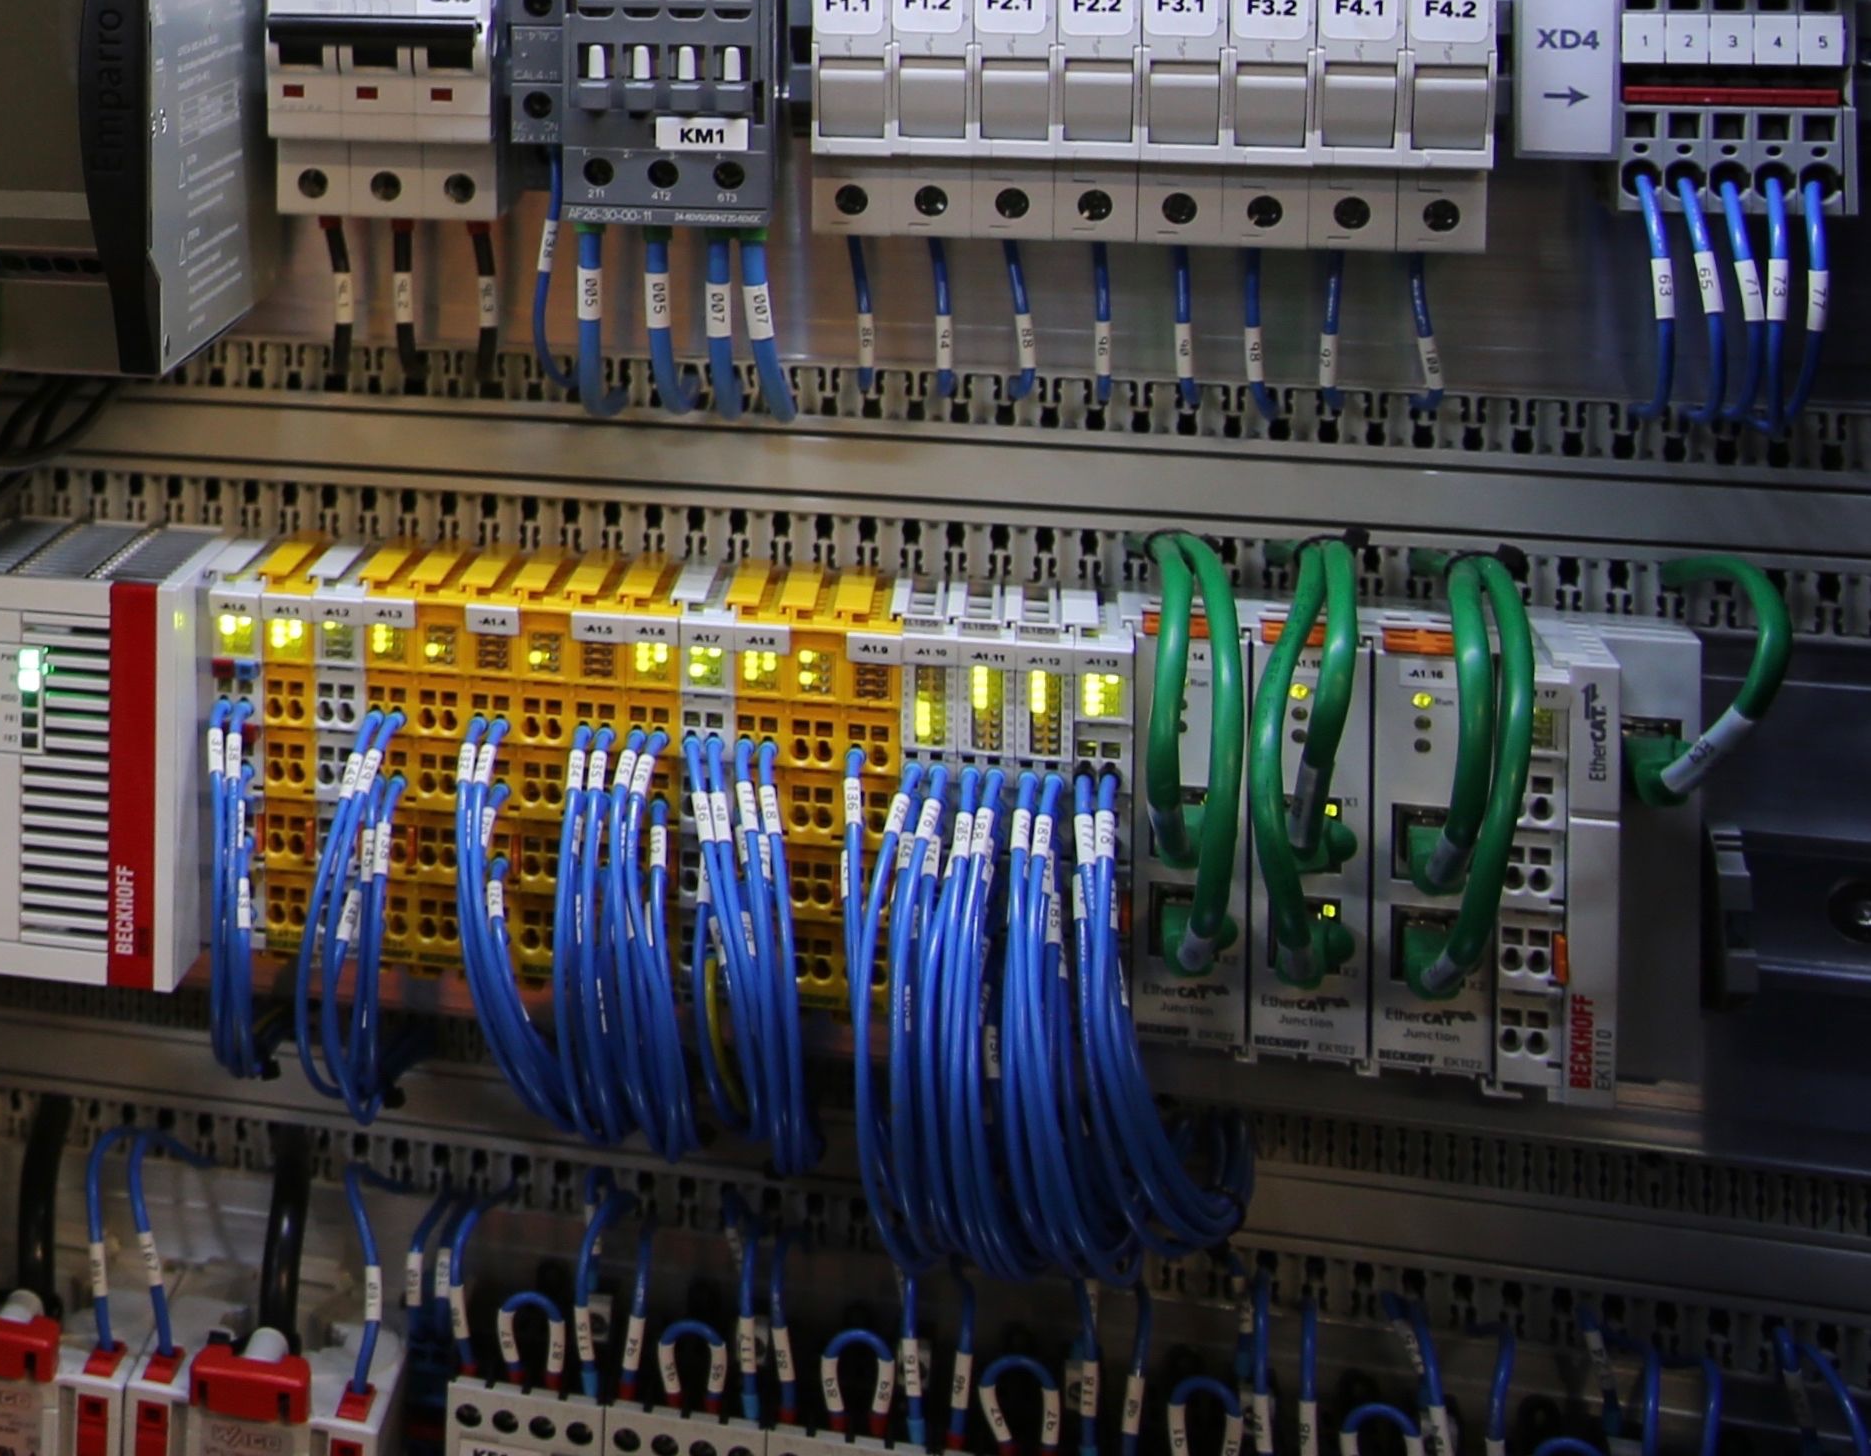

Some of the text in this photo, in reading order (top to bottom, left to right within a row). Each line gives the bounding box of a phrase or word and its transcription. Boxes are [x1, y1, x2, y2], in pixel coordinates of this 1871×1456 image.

[1247, 0, 1297, 16] F3.2
[1426, 0, 1478, 18] F4.2
[1537, 29, 1600, 51] XD4
[1644, 35, 1828, 49] 1 2 3 4 5
[680, 128, 727, 145] KM1
[588, 190, 606, 200] 2T1
[651, 192, 672, 202] 4T2
[1658, 274, 1672, 296] 63
[1699, 267, 1714, 291] 65
[1745, 279, 1759, 296] 71
[1773, 276, 1787, 298] 73
[585, 278, 599, 307] 005
[653, 282, 667, 314] 005
[1813, 287, 1827, 310] 77
[711, 292, 726, 323] 007
[753, 293, 769, 324] 007
[940, 329, 949, 349] 94
[1023, 327, 1035, 348] 88
[1098, 337, 1109, 356] 96
[1250, 342, 1261, 362] 98
[478, 618, 506, 627] -A1.4
[584, 625, 612, 635] -A1.5
[692, 633, 720, 643] -A1.7
[972, 653, 1005, 662] -A1.11
[1410, 669, 1444, 680] -A1.16
[116, 866, 135, 956] BECKHOFF
[1160, 1003, 1215, 1017] Junction
[1280, 1014, 1334, 1029] Junction
[1255, 1036, 1309, 1051] BECKHOFF
[1404, 1028, 1461, 1044] Junction
[1570, 995, 1594, 1091] BECKHOFF
[1380, 1049, 1435, 1064] BECKHOFF
[1596, 1031, 1612, 1093] EK1110
